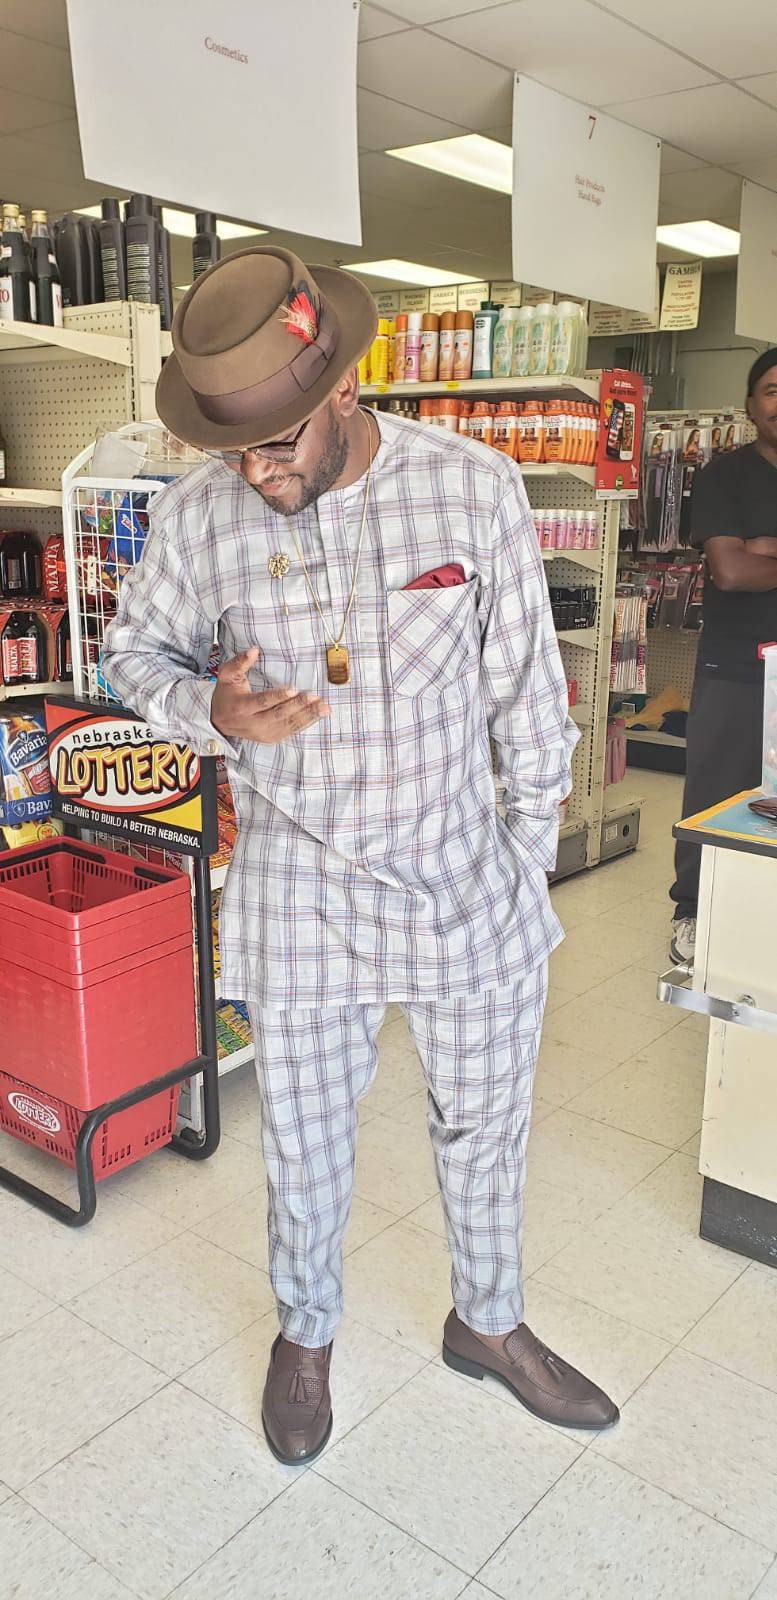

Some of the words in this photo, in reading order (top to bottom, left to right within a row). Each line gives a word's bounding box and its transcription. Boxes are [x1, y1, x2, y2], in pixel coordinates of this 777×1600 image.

[204, 36, 249, 65] Cosmetics
[587, 115, 597, 140] 7
[47, 543, 60, 593] MALTA
[10, 645, 18, 672] MALTA
[72, 726, 154, 744] nebraska
[10, 735, 47, 767] Bavaria
[57, 742, 195, 796] LOTTERY
[27, 799, 53, 815] Bav
[62, 803, 90, 819] HELPING
[91, 810, 100, 821] TO
[101, 813, 121, 827] BUILD
[122, 819, 129, 830] A
[130, 820, 157, 837] BETTER
